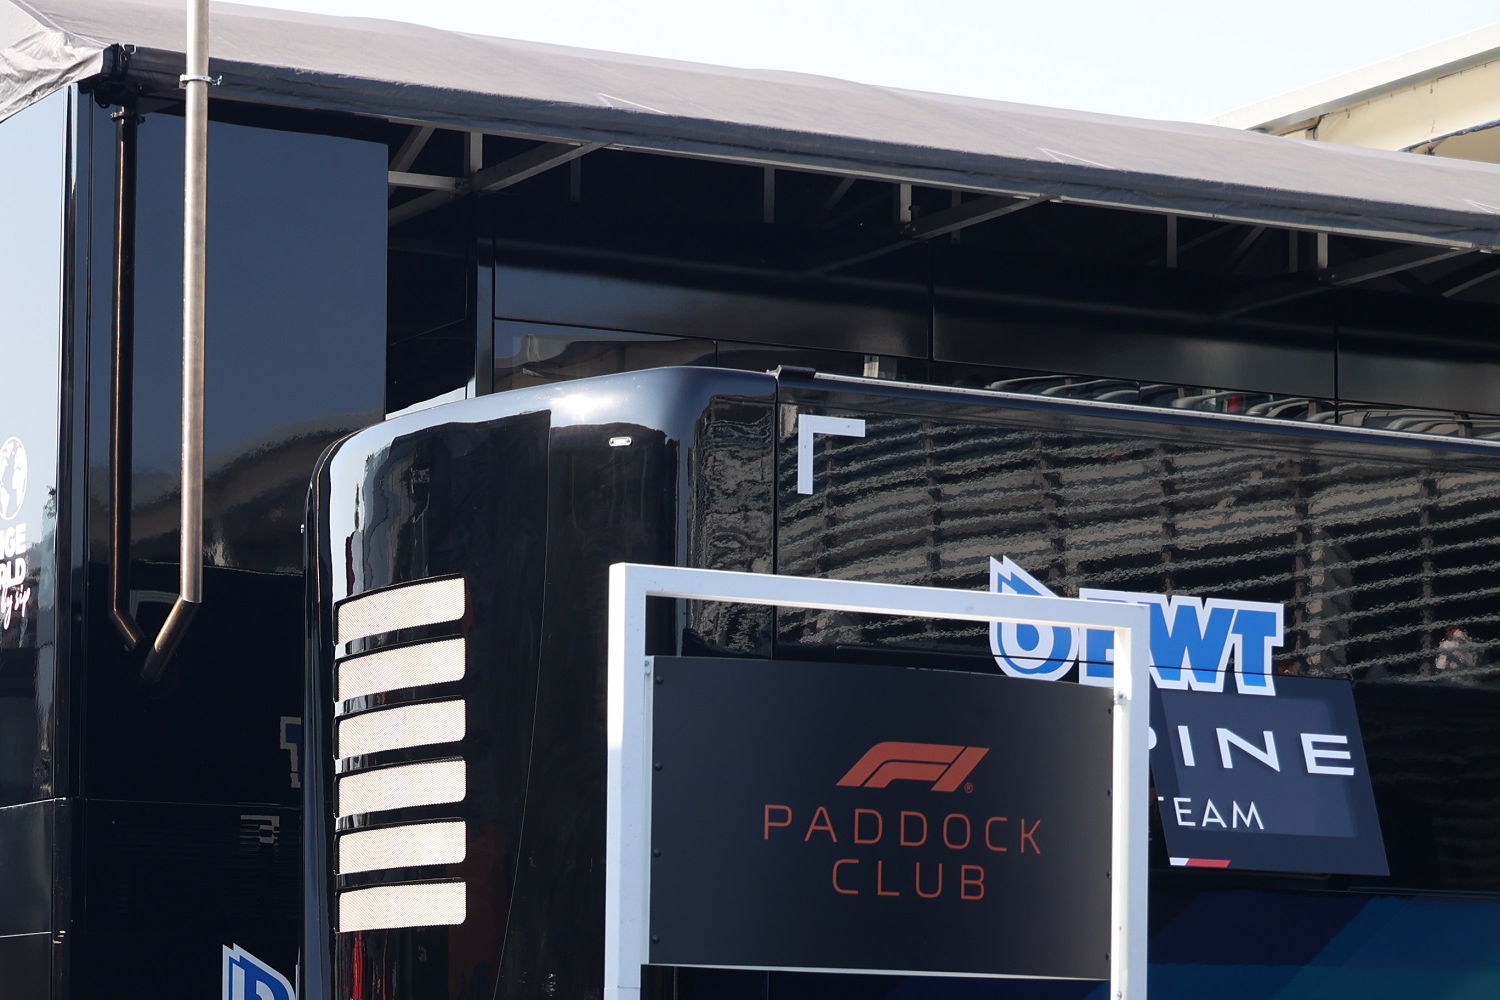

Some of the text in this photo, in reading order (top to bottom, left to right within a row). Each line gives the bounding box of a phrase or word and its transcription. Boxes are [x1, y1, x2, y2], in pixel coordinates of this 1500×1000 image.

[763, 804, 1042, 855] PADDOCK
[1158, 796, 1265, 830] EAM
[831, 858, 986, 901] CLUB
